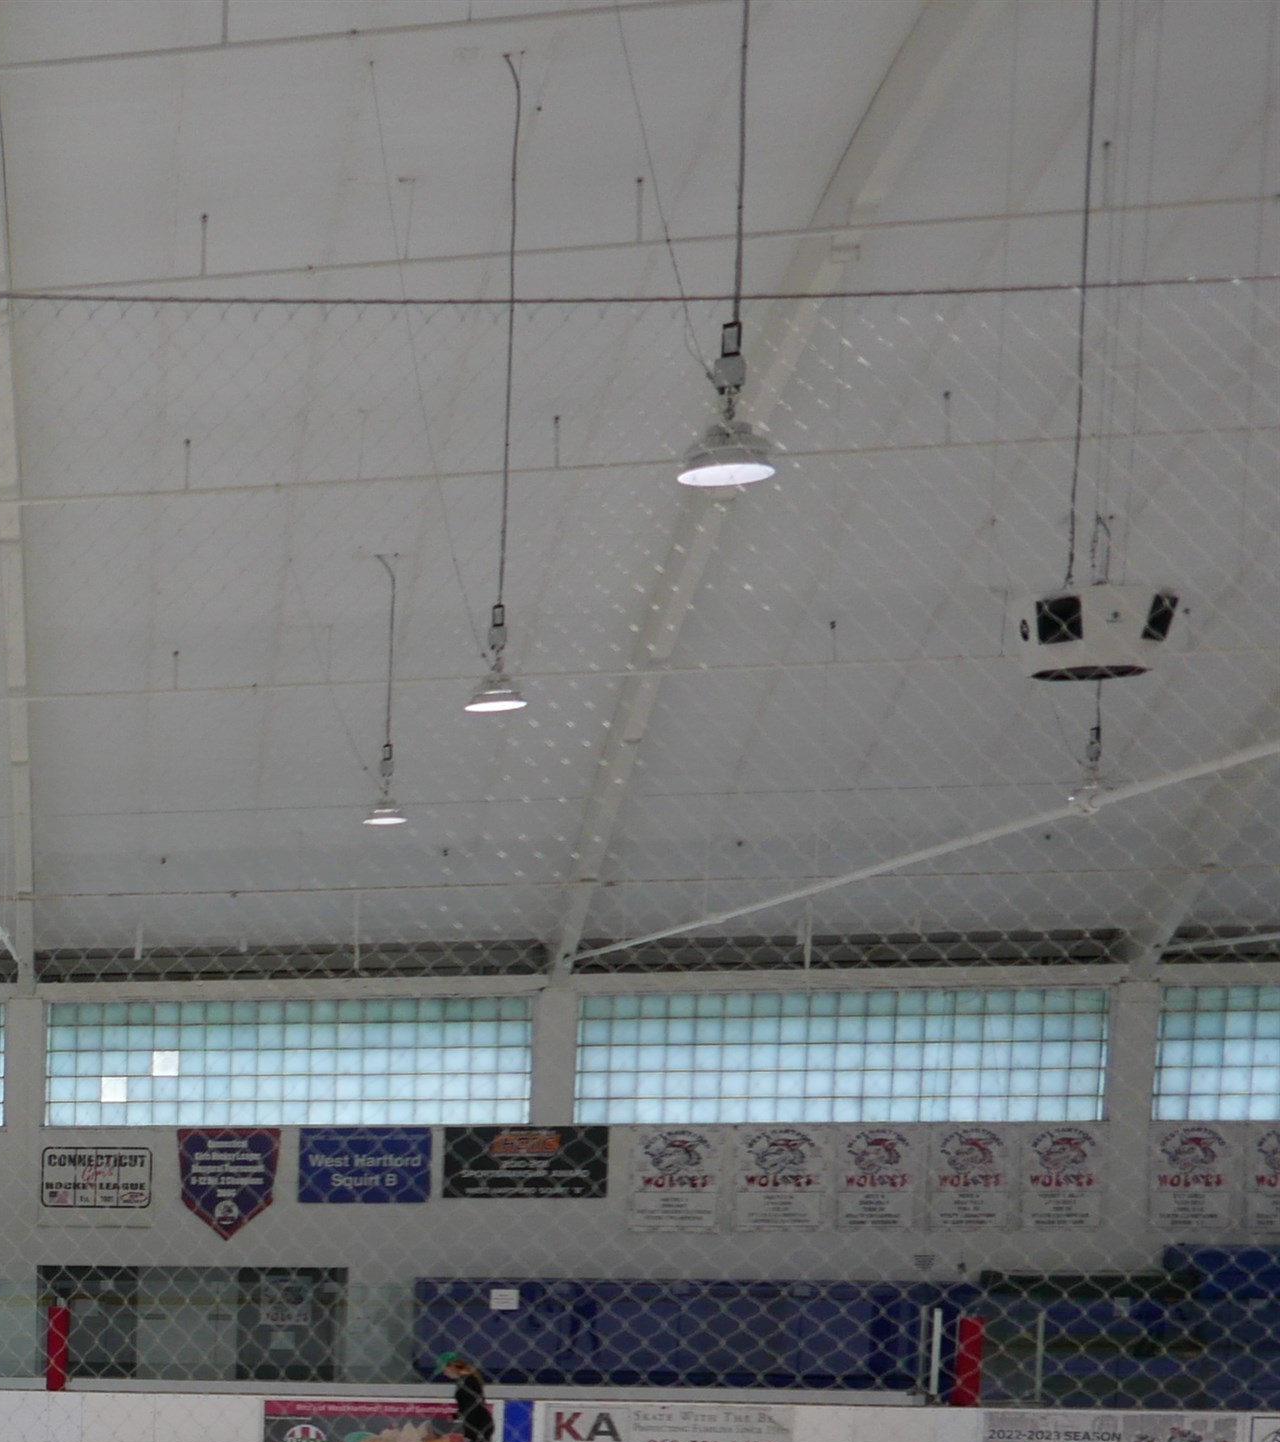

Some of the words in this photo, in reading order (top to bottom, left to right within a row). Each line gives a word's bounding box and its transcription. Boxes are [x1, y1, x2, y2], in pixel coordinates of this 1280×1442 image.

[47, 1154, 147, 1168] CONNECTICUT
[309, 1154, 348, 1168] West
[354, 1153, 423, 1168] Hartford
[45, 1182, 96, 1190] HOCKEY
[99, 1182, 146, 1191] LEAGUE
[331, 1172, 378, 1188] Squirt
[384, 1172, 398, 1186] B
[642, 1174, 710, 1188] WOLVES
[744, 1174, 814, 1187] WOLVES
[553, 1411, 623, 1442] KA
[989, 1429, 1060, 1441] 2022-2023
[1063, 1430, 1123, 1442] SEASON
